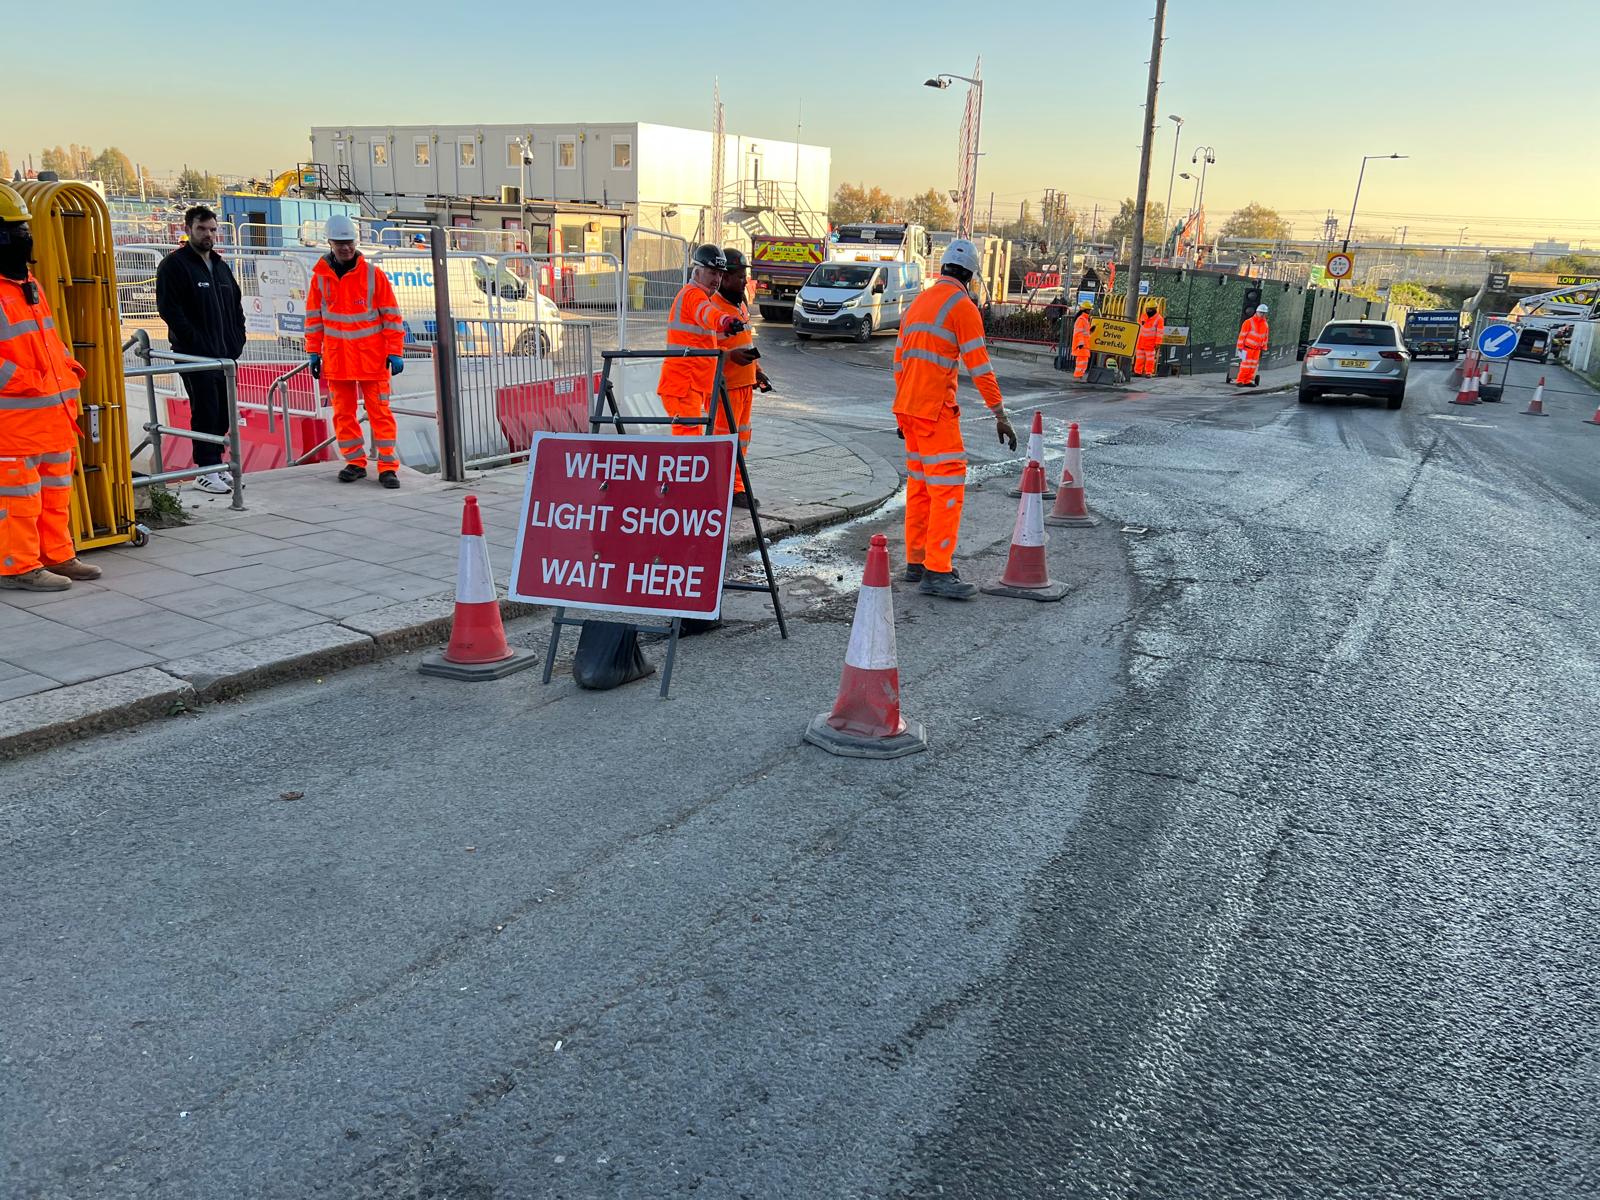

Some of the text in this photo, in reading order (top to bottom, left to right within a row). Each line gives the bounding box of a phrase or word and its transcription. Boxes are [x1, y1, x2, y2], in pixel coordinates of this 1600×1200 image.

[385, 266, 434, 287] ernic
[1102, 322, 1126, 332] Please
[1103, 331, 1122, 340] Drive
[1094, 338, 1127, 350] Carefully
[564, 451, 710, 483] WHEN RED
[531, 501, 723, 537] LIGHT SHOWS
[541, 558, 705, 598] WAIT HERE
